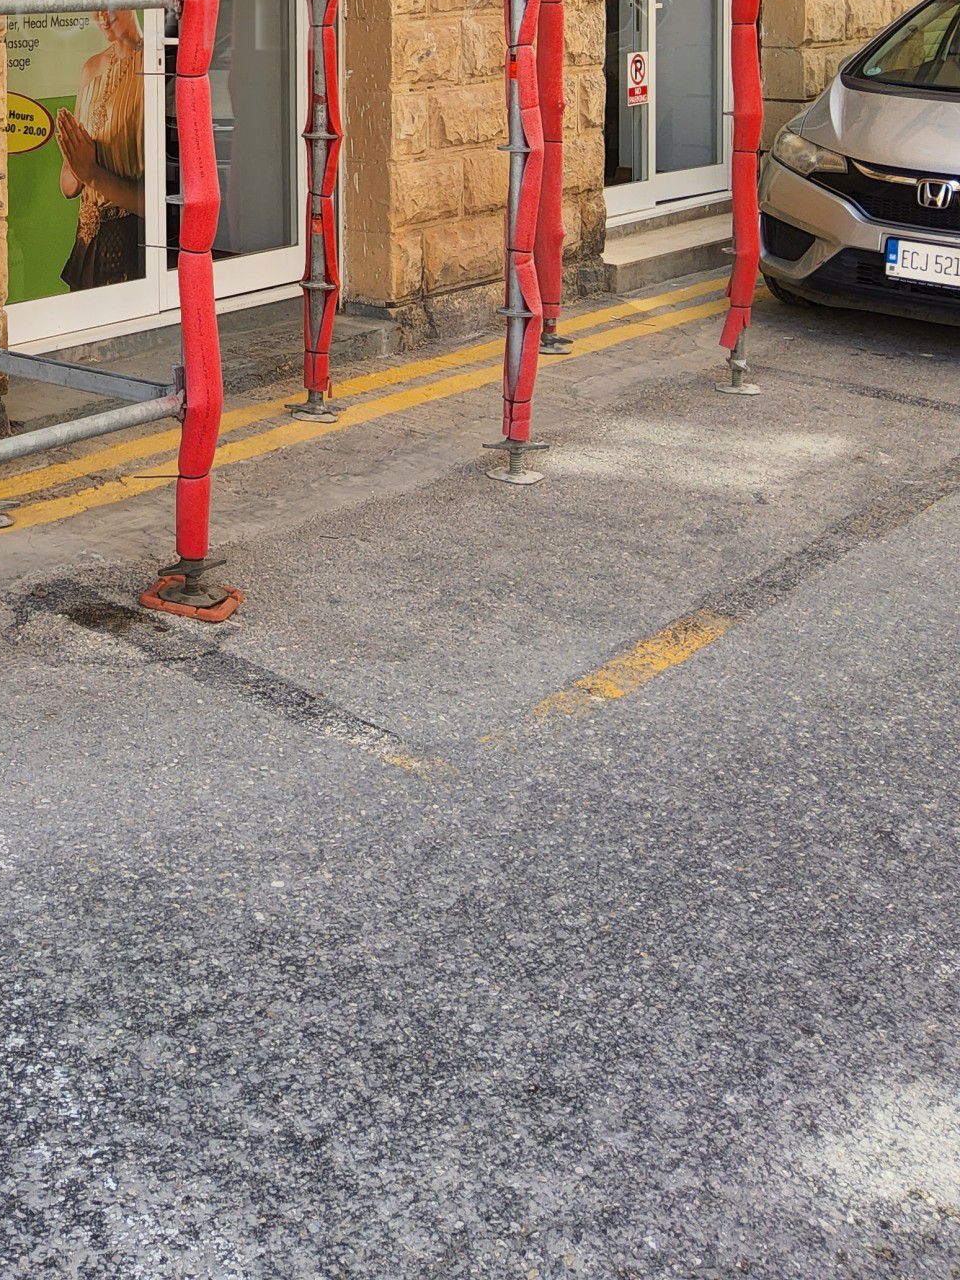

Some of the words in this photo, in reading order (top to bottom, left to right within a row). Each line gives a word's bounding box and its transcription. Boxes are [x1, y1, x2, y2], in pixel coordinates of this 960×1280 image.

[23, 13, 48, 29] Head
[50, 15, 90, 30] Massage
[6, 58, 31, 71] sage
[8, 110, 35, 122] Hours
[22, 125, 47, 137] 20.00
[901, 249, 929, 272] ECJ
[934, 254, 960, 276] 521
